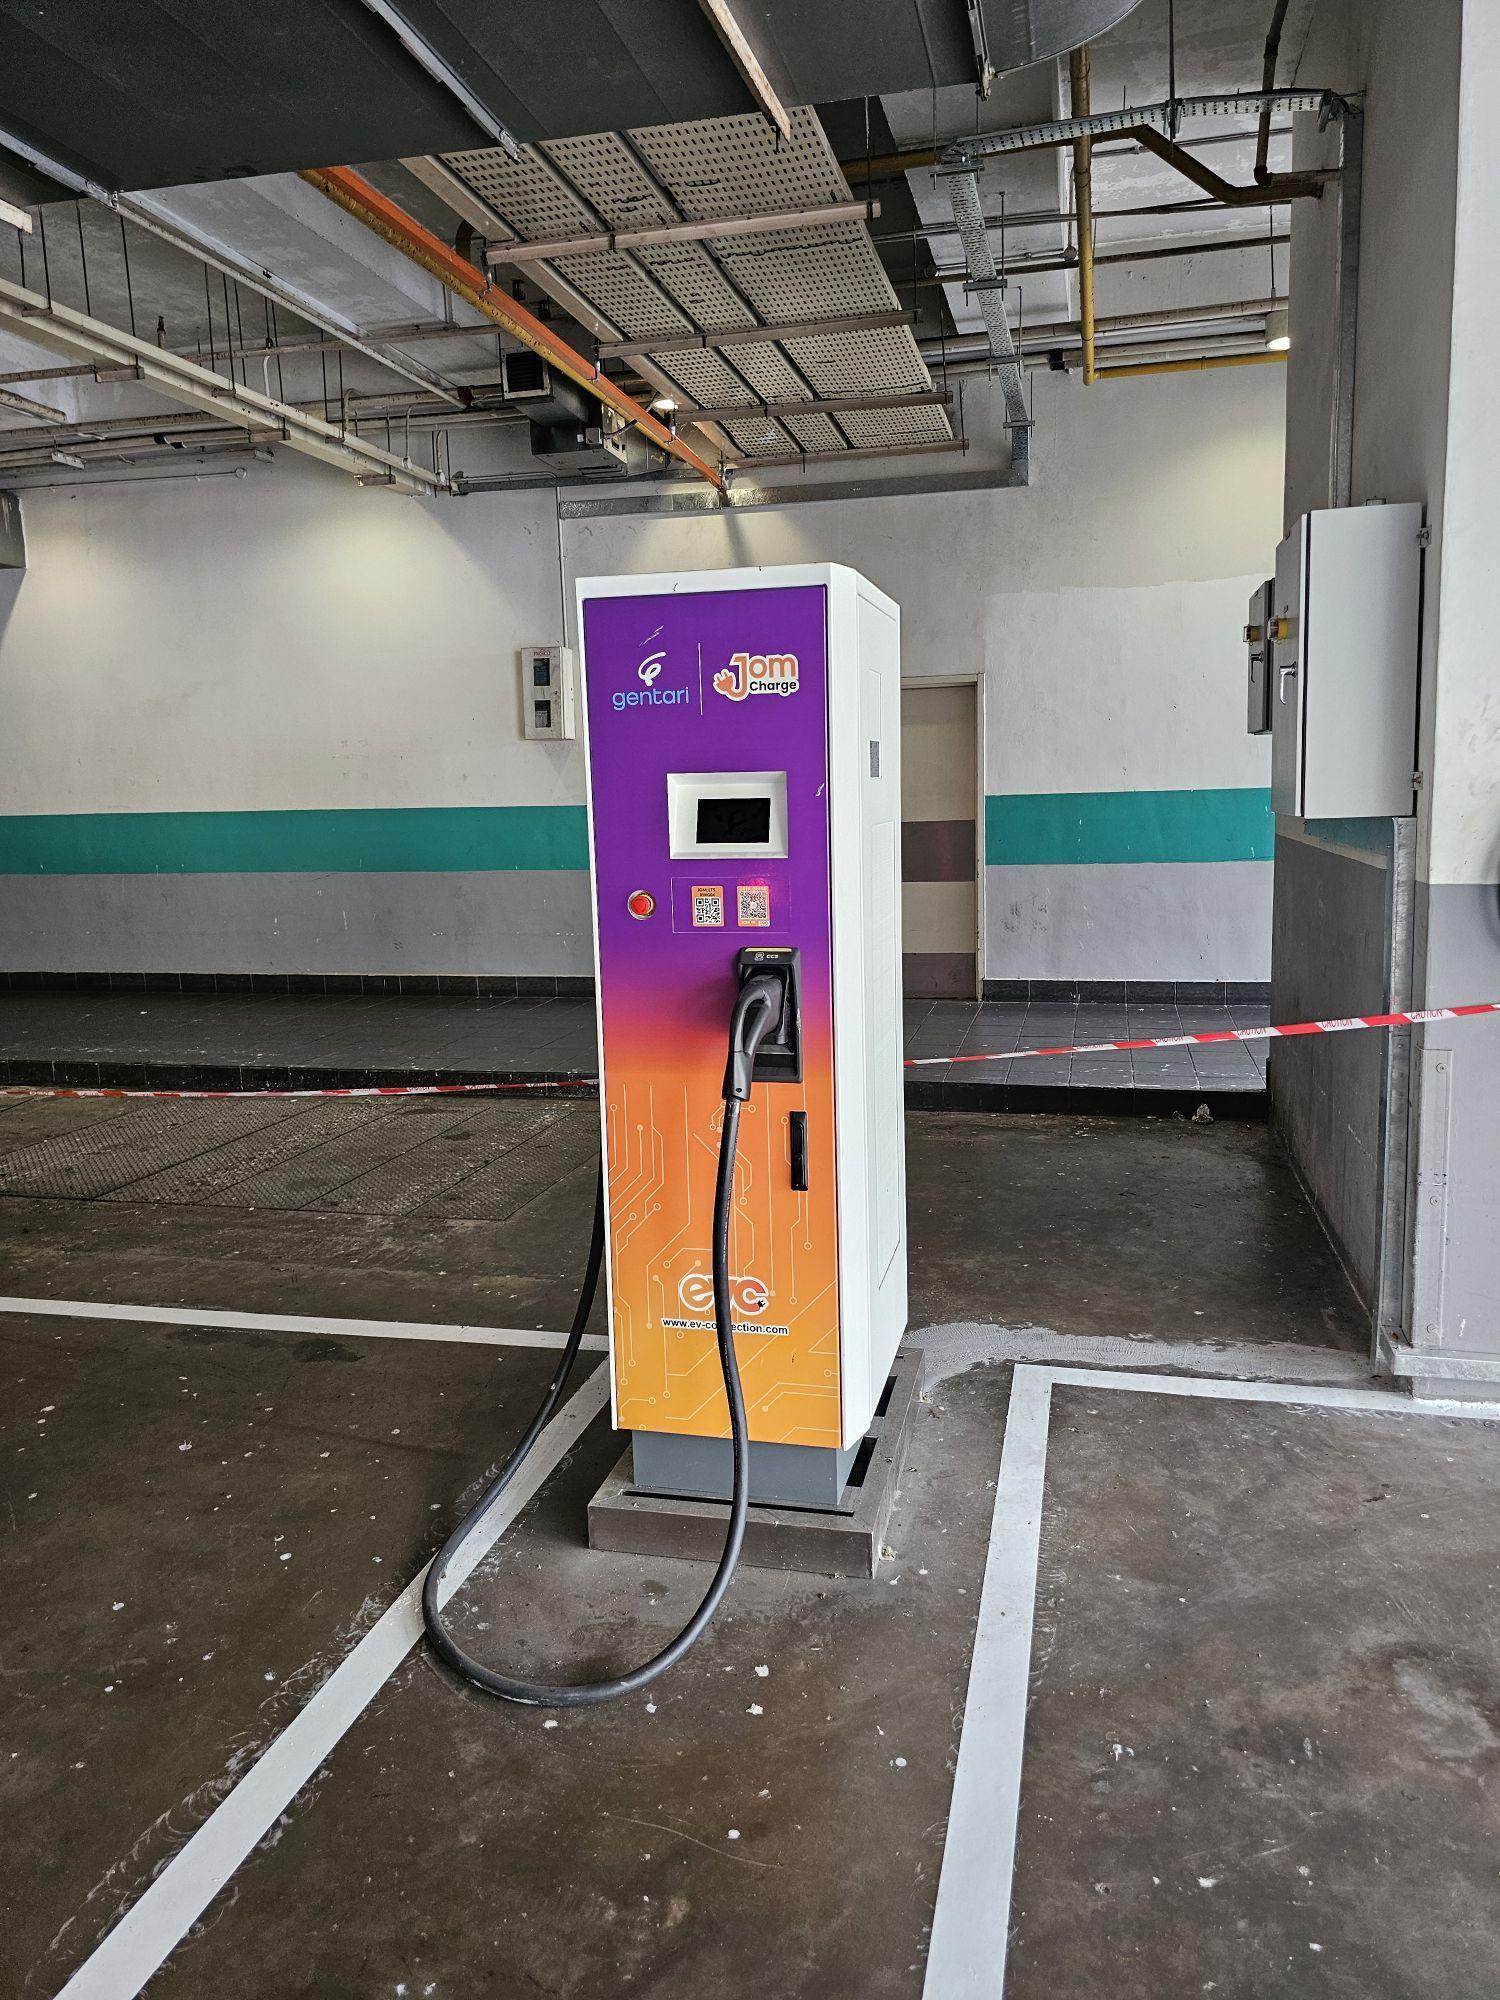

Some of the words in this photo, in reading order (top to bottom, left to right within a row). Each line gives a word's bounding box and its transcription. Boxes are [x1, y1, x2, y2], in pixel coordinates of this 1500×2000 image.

[727, 654, 797, 700] Jom
[749, 680, 797, 693] Charge
[612, 686, 689, 711] gentari
[1411, 1009, 1443, 1020] CAUTION
[1321, 1018, 1353, 1029] CAUTION
[662, 1318, 788, 1335] www.ev-coection.com
